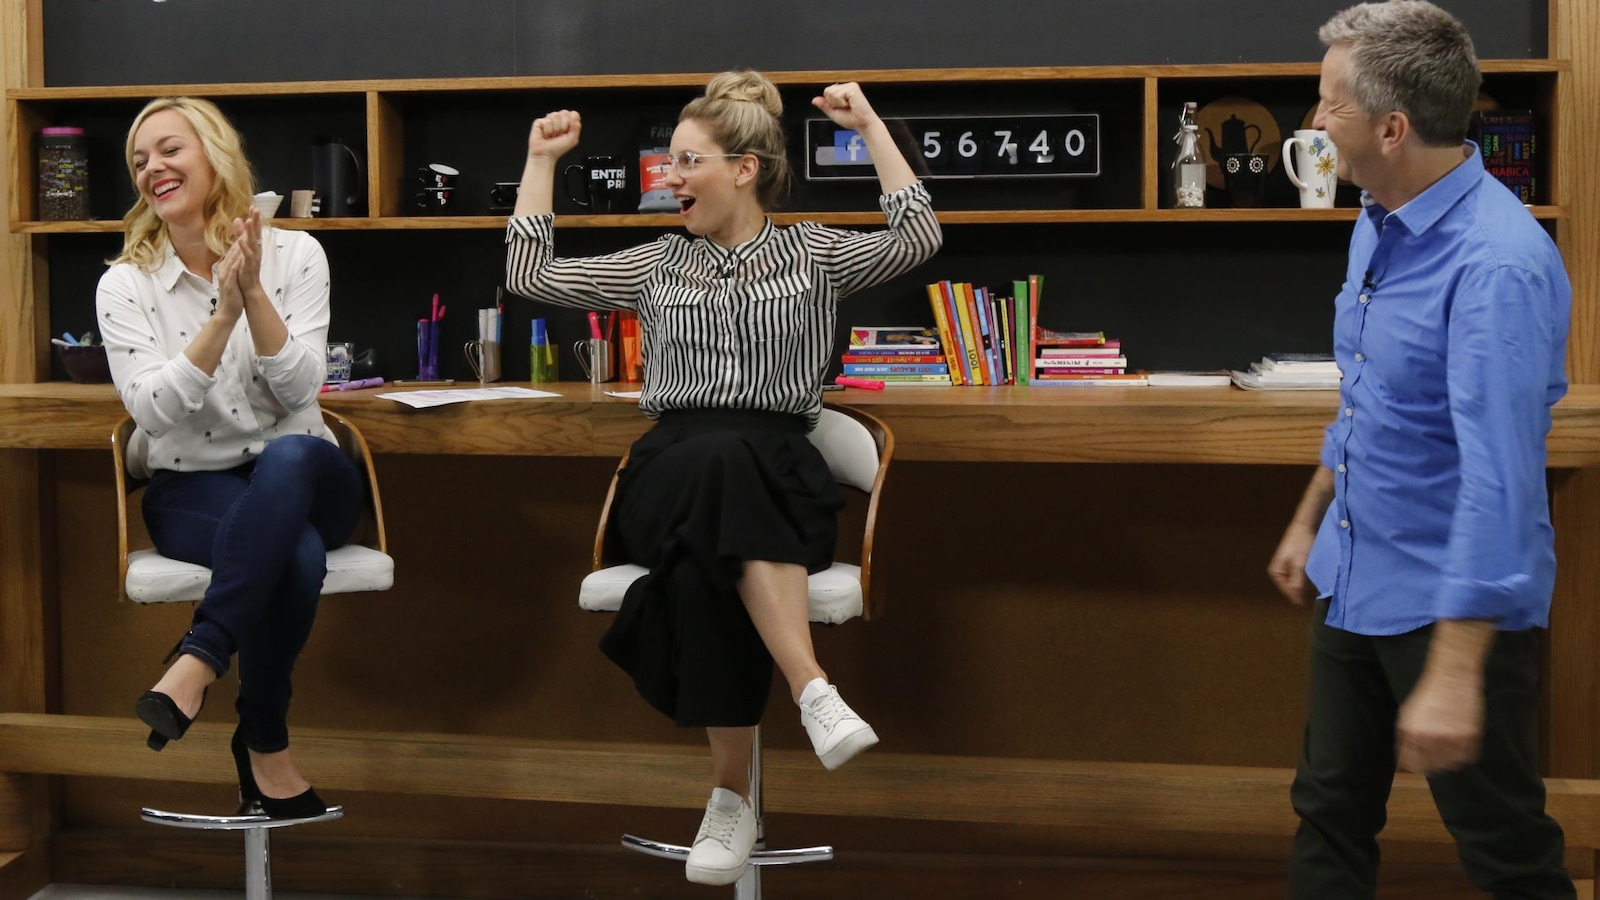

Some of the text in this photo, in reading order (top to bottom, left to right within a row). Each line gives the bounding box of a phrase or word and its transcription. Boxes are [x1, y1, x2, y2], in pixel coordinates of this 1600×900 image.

[1483, 134, 1492, 157] MENU
[1492, 134, 1500, 152] DARK
[968, 349, 979, 369] 1001
